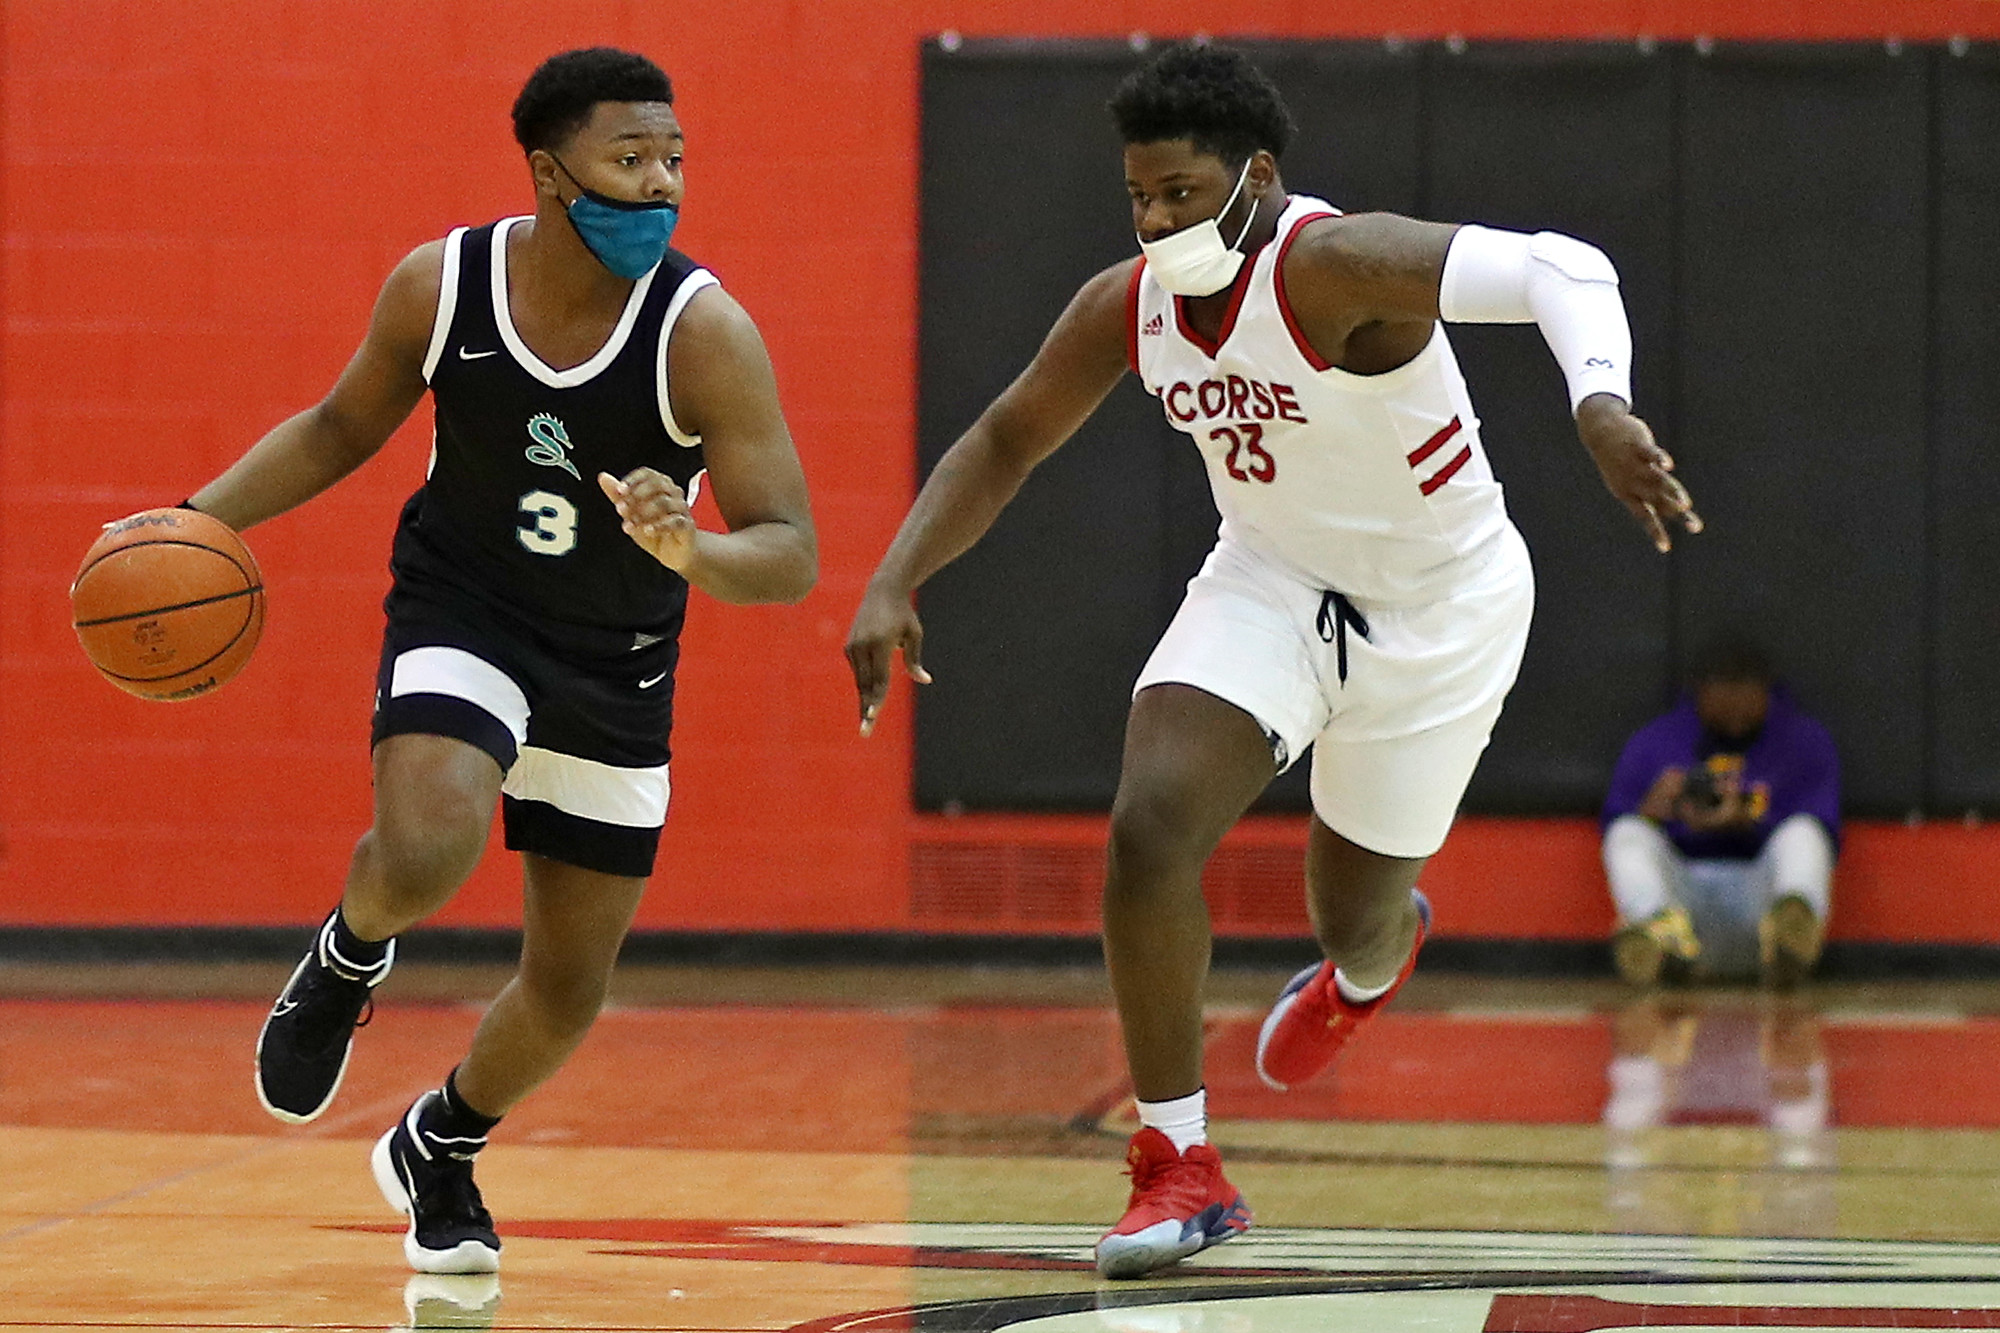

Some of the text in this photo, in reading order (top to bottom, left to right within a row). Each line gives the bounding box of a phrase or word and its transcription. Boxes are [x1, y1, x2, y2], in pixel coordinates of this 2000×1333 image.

[1156, 375, 1308, 423] CORSE
[1210, 423, 1276, 483] 23
[517, 490, 578, 556] 3
